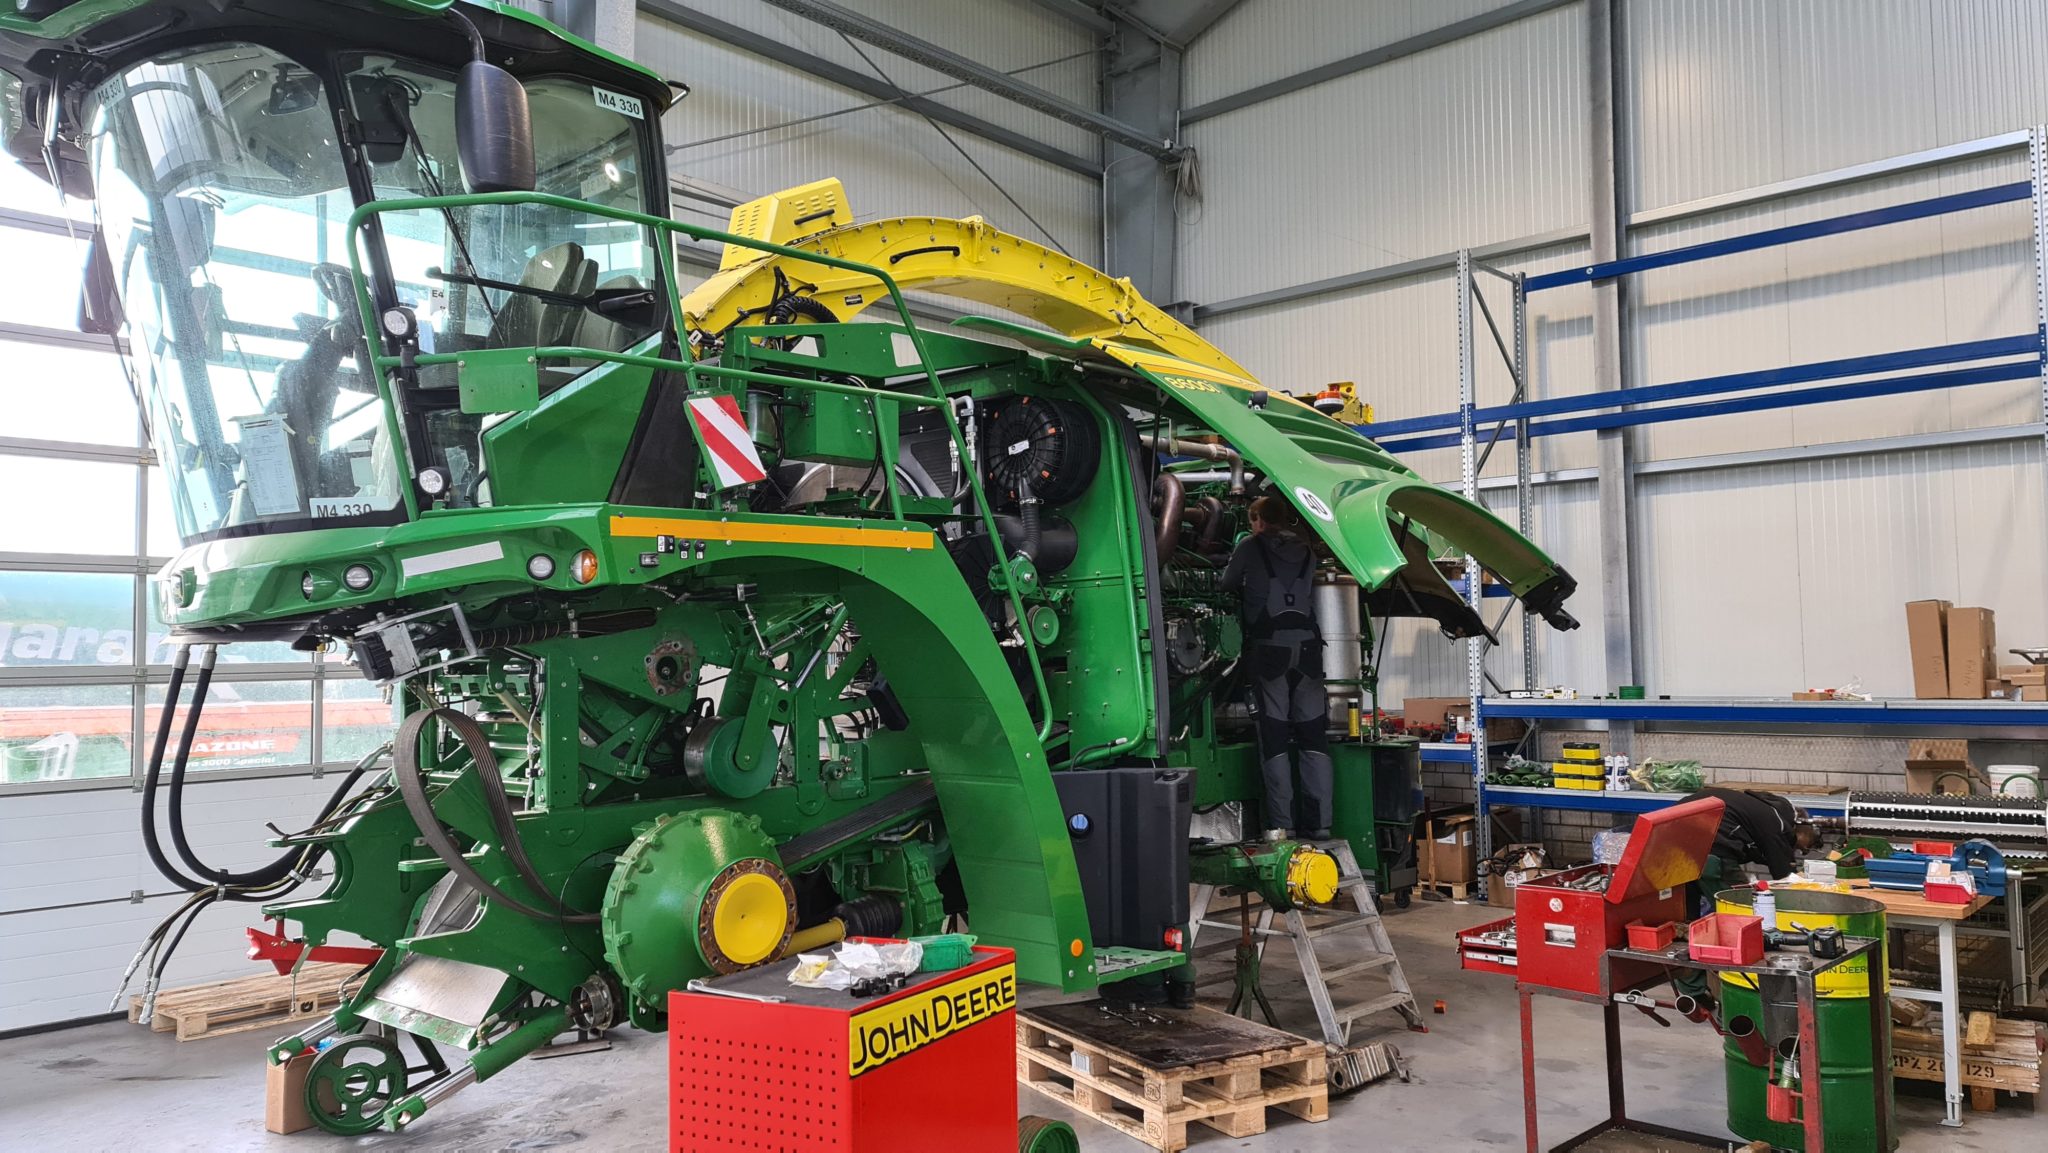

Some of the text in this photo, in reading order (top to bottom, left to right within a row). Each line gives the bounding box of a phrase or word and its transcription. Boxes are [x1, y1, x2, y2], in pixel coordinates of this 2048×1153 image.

[598, 91, 640, 115] M4 330
[316, 503, 372, 517] M4 330
[1302, 492, 1329, 516] 40
[1839, 964, 1869, 974] DEER
[852, 974, 1015, 1070] JOHN DEERE
[1966, 1063, 1995, 1078] 129
